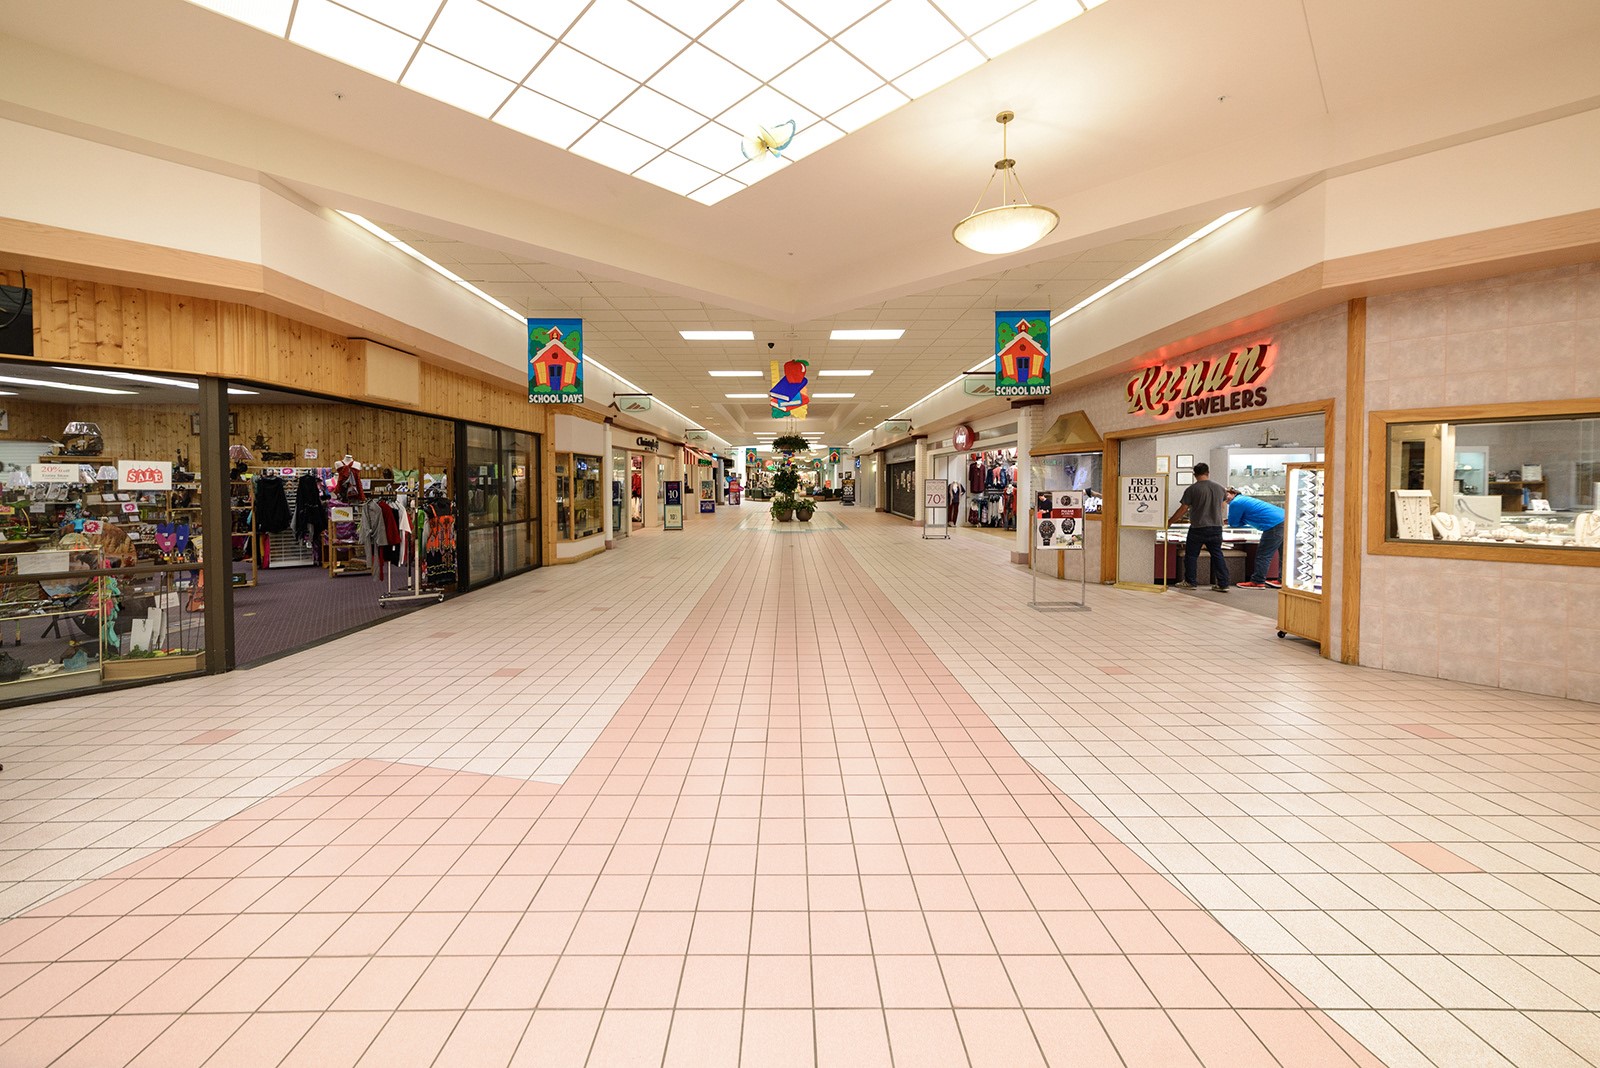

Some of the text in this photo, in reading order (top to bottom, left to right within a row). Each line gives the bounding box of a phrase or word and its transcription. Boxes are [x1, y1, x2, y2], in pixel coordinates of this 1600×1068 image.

[1125, 344, 1271, 416] Keenan
[996, 385, 1050, 395] SCHOOL DAYS
[529, 394, 582, 403] SCHOOL DAYS
[1175, 386, 1268, 419] JEWELERS
[128, 471, 163, 482] SALE
[1131, 478, 1156, 486] FREE
[1128, 493, 1158, 501] EXAM
